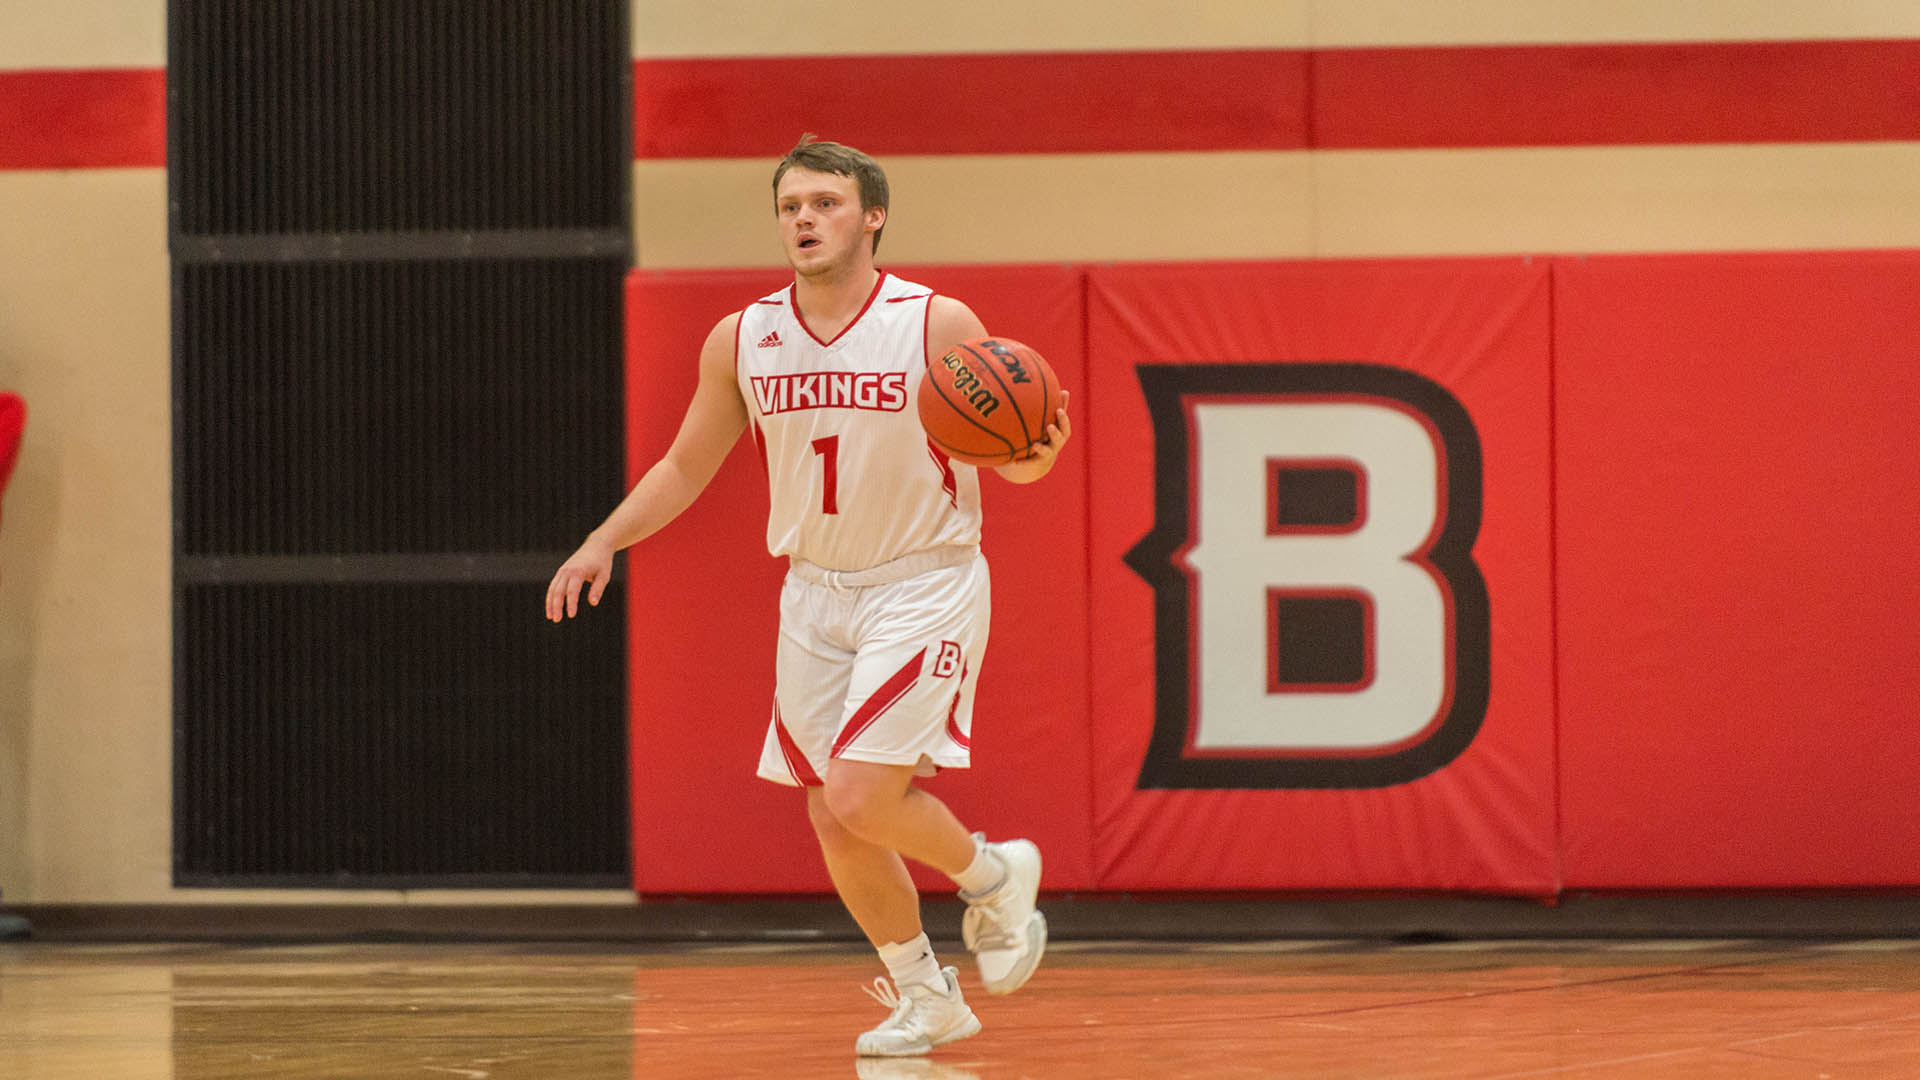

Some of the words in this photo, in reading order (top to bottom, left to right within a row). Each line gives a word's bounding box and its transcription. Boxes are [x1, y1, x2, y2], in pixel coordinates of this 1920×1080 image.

[750, 372, 908, 416] VIKINGS
[942, 351, 1000, 418] Wilson
[811, 435, 839, 514] 1
[1121, 362, 1492, 790] B
[932, 640, 961, 678] B
